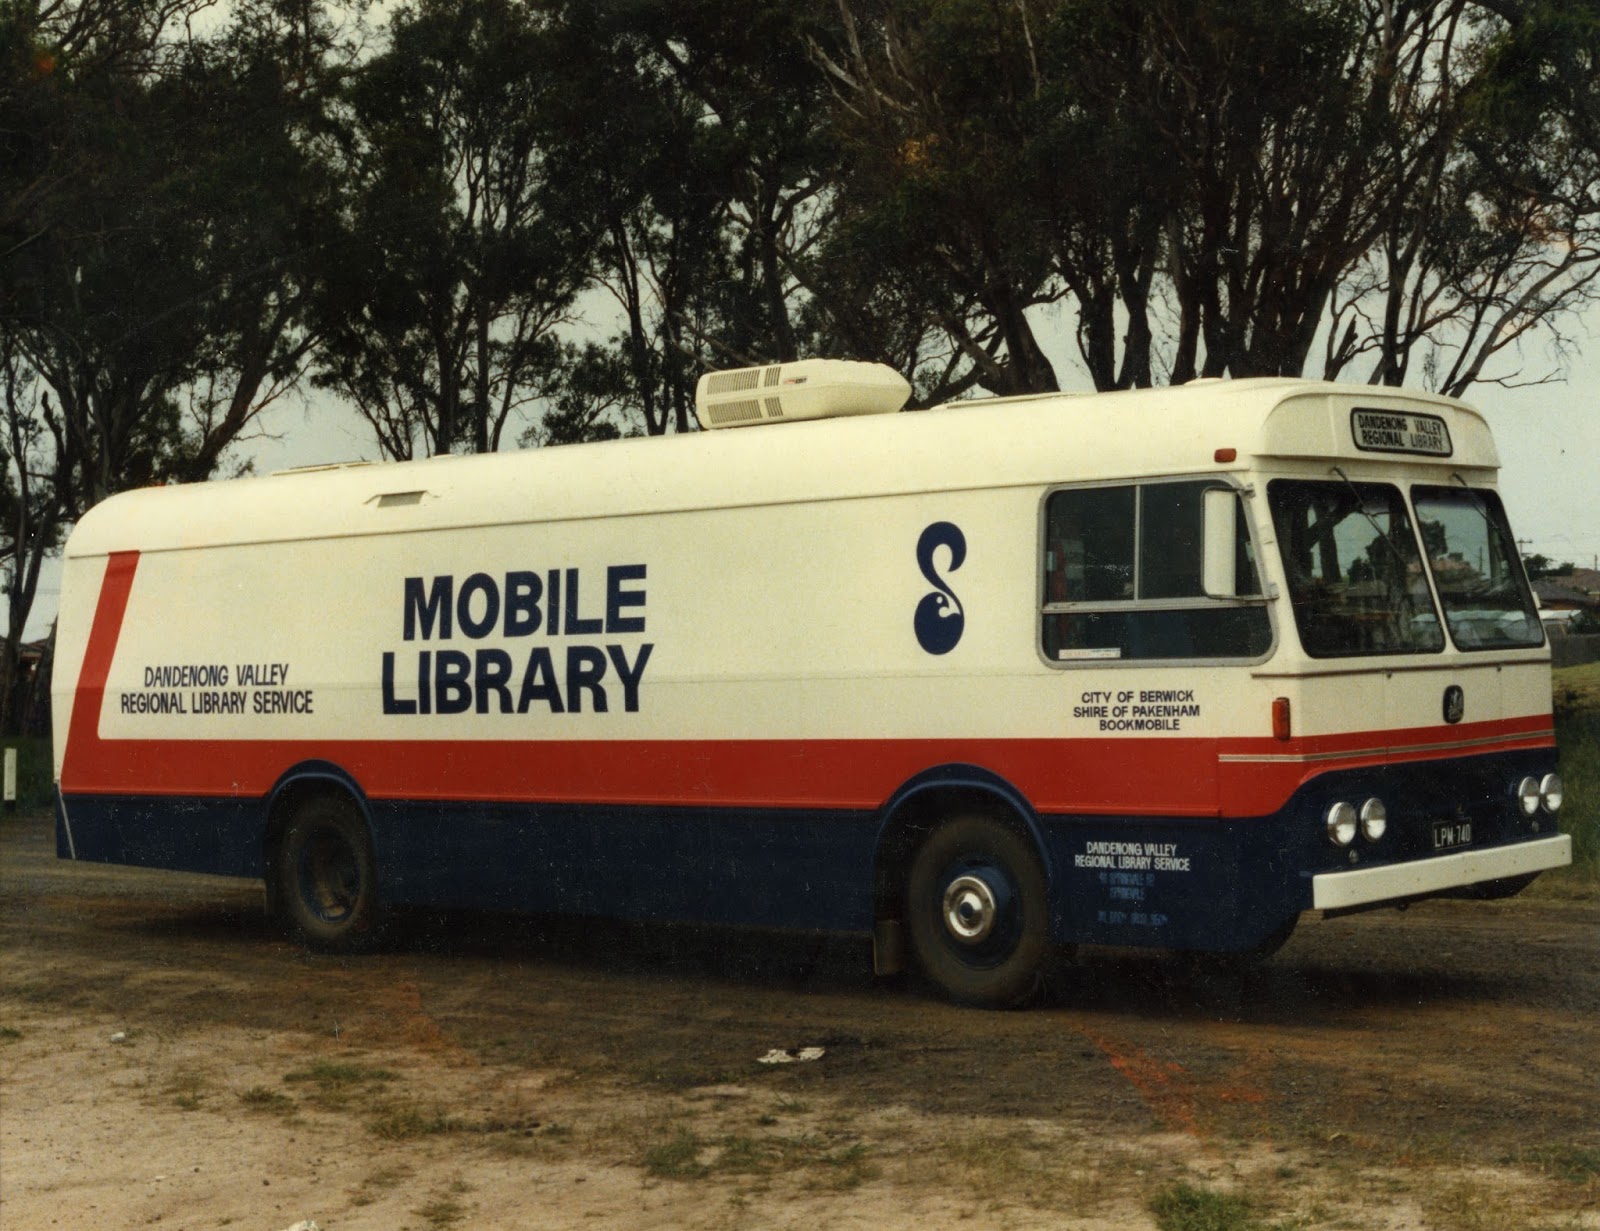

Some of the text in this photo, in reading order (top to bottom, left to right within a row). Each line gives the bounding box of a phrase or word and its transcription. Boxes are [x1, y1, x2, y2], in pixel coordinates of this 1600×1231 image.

[1358, 414, 1442, 436] DANDENONG VALLEY
[1362, 430, 1442, 450] REGIONAL LIBRARY
[403, 564, 648, 641] MOBILE
[144, 664, 289, 688] DANDENONG VALLEY
[381, 643, 655, 715] LIBRARY
[121, 690, 313, 714] REGIONAL LIBRARY SERVICE
[1082, 690, 1194, 704] CITY OF BERWICK
[1073, 704, 1200, 718] SHIRE OF PAKENHAM
[1099, 718, 1180, 731] BOOKMOBILE
[1086, 841, 1177, 856] DANDENONG VALLEY
[1074, 855, 1190, 871] REGIONAL LIBRARY SERVICE
